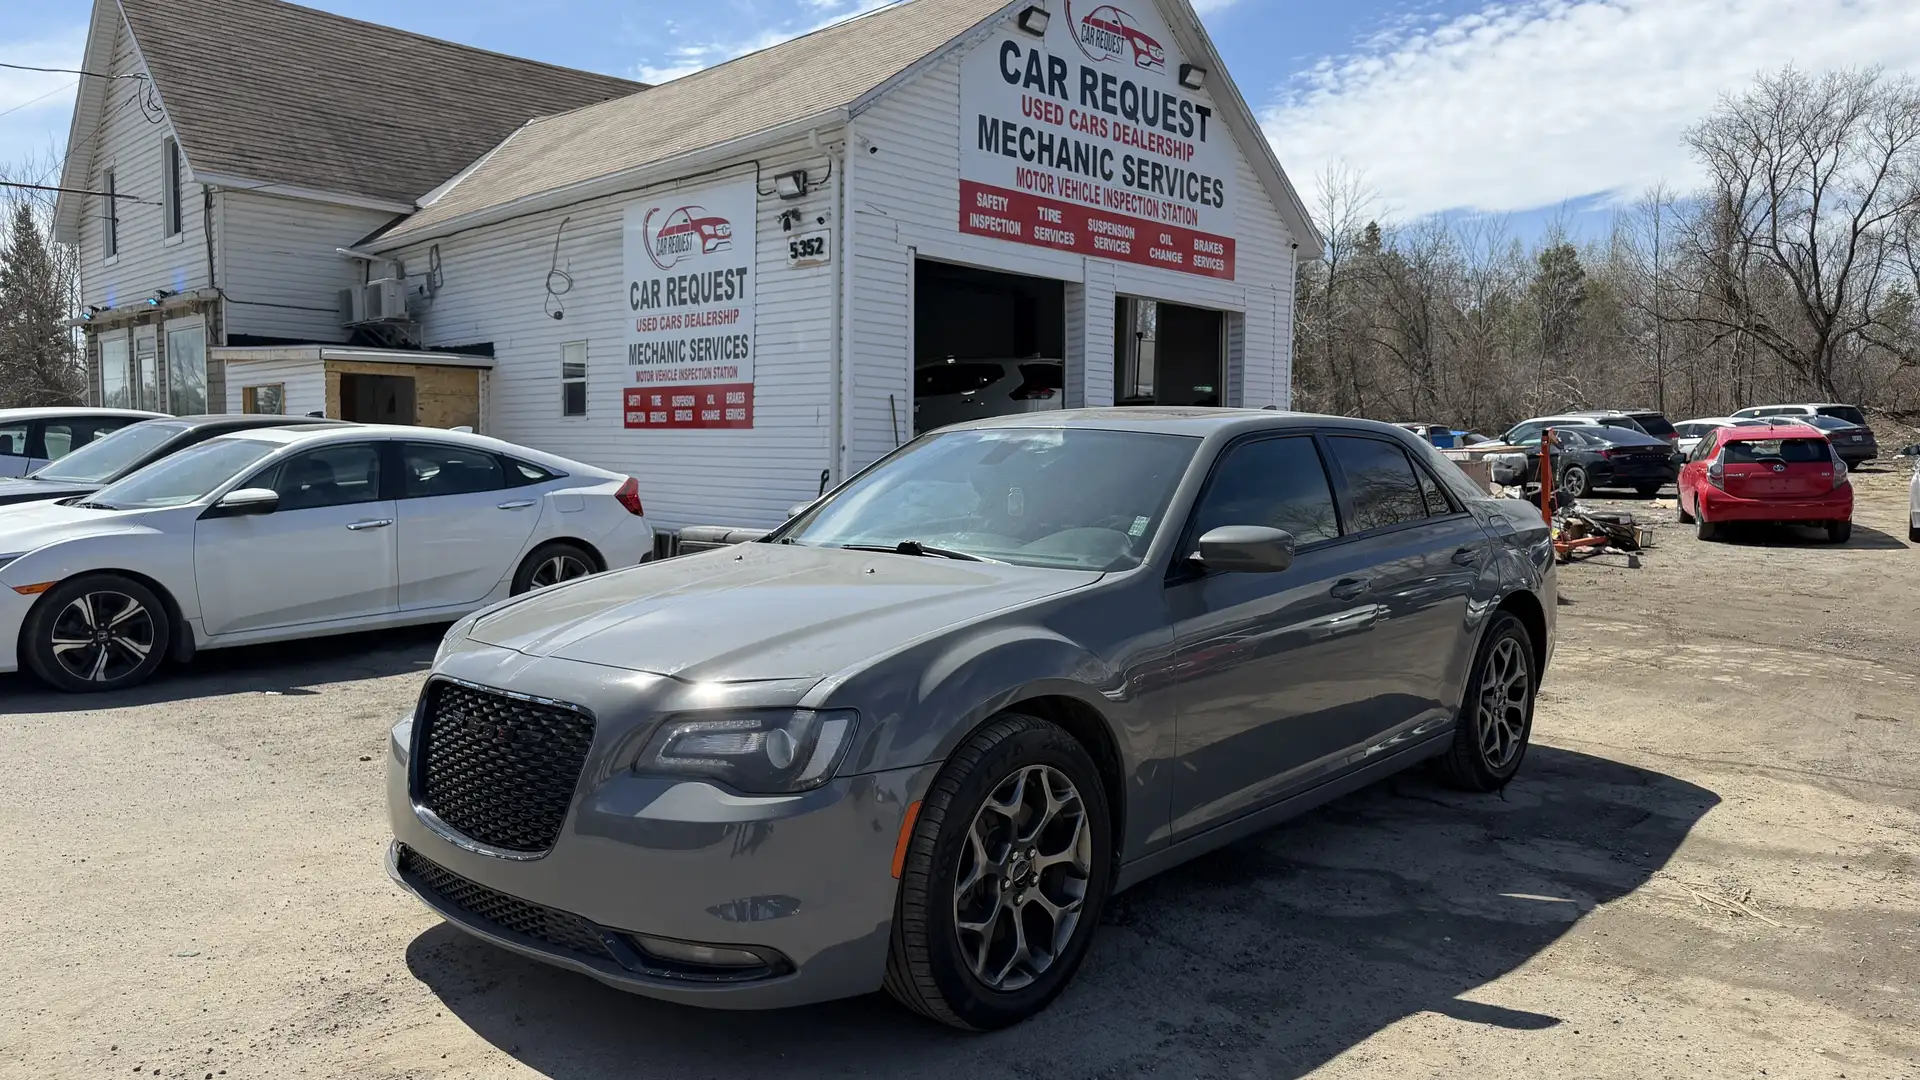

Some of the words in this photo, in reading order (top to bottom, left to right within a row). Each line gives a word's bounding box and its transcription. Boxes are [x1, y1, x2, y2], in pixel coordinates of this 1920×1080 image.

[1081, 23, 1095, 46] CAR
[1095, 28, 1124, 55] REQUEST
[1000, 39, 1068, 101] CAR
[1080, 65, 1211, 142] REQUEST
[1022, 94, 1064, 126] USED
[1069, 108, 1108, 138] CARS
[1113, 121, 1194, 163] DEALERSHIP
[978, 114, 1114, 181] MECHANIC
[1122, 154, 1224, 209] SERVICES
[976, 191, 1009, 212] SAFETY
[1016, 166, 1054, 196] MOTOR
[1057, 176, 1100, 205] VEHICLE
[1103, 187, 1159, 219] INSPECTION
[1161, 201, 1198, 227] STATION
[969, 212, 1021, 236] INSPECTION
[1037, 206, 1062, 224] TIRE
[1033, 225, 1075, 246] SERVICES
[1087, 218, 1135, 240] SUSPENSION
[1159, 233, 1173, 246] OIL
[656, 236, 667, 256] CAR
[668, 231, 694, 254] REQUEST
[789, 236, 824, 259] 5352
[1093, 235, 1131, 254] SERVICES
[1193, 238, 1224, 255] BRAKES
[1149, 247, 1183, 264] CHANGE
[1193, 255, 1225, 271] SERVICES
[629, 279, 661, 311] CAR
[666, 267, 748, 307] REQUEST
[636, 317, 658, 332] USED
[659, 314, 682, 330] CARS
[684, 308, 740, 328] DEALERSHIP
[628, 339, 686, 366] MECHANIC
[689, 333, 749, 362] SERVICES
[635, 370, 654, 383] MOTOR
[655, 368, 678, 382] VEHICLE
[678, 366, 711, 381] INSPECTION
[713, 365, 739, 379] STATION
[726, 391, 746, 405] BRAKES
